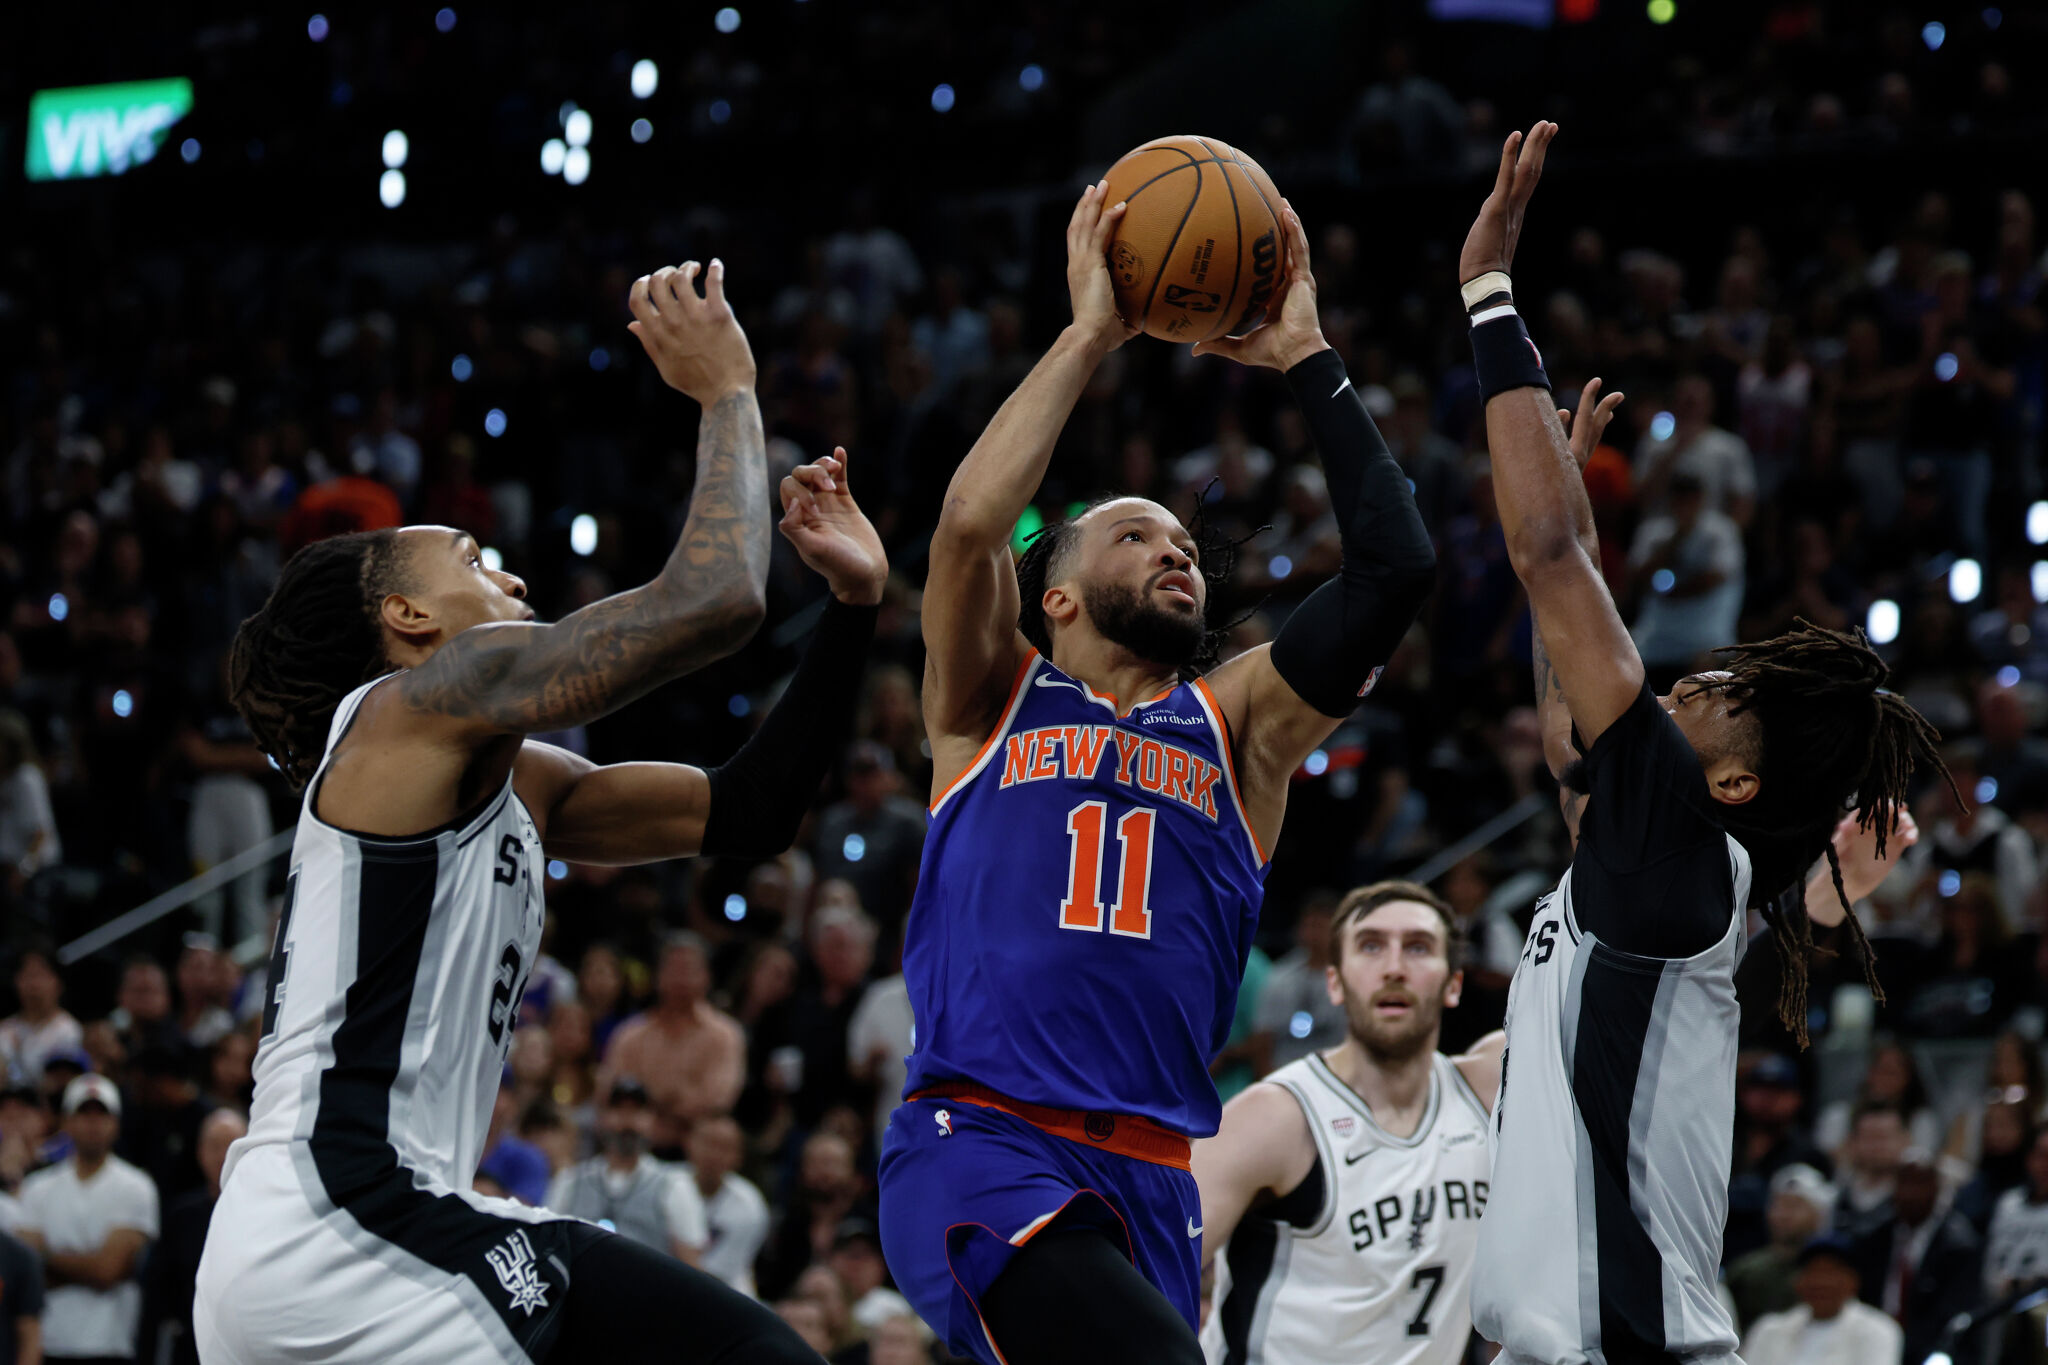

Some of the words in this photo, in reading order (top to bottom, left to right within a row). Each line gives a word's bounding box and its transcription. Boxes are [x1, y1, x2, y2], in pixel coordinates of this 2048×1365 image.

[1142, 715, 1167, 725] abu
[1169, 714, 1205, 726] dhabi
[999, 724, 1111, 790] NEW
[1113, 726, 1223, 825] YORK
[1058, 799, 1157, 940] 11
[1348, 1180, 1491, 1252] SPURS
[1407, 1264, 1446, 1337] 7
